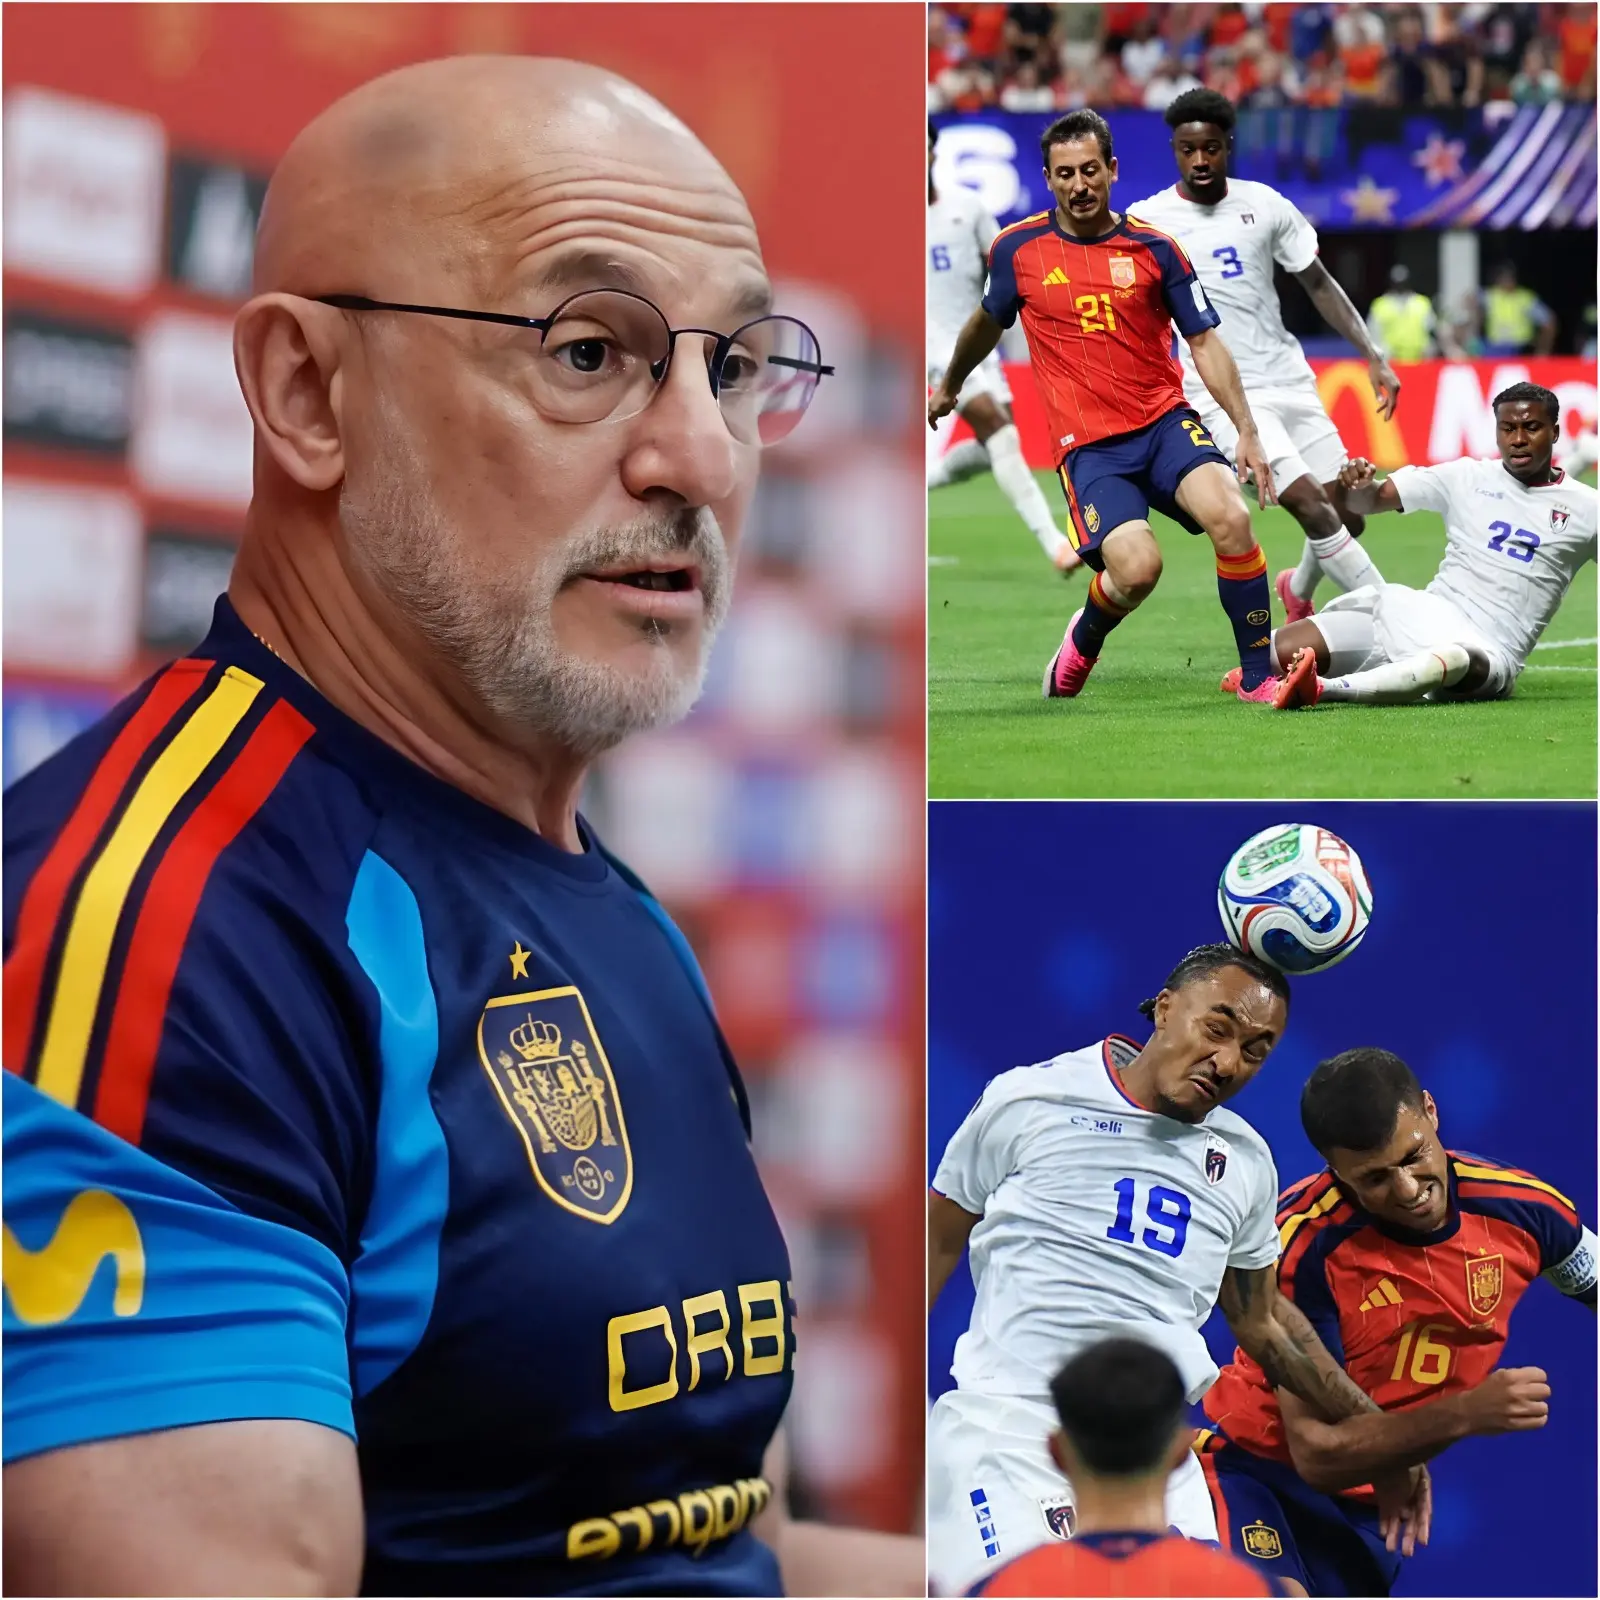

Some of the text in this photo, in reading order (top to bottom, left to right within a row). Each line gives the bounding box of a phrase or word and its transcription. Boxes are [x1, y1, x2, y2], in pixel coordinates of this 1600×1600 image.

[1213, 246, 1244, 279] 3
[1075, 293, 1116, 333] 21
[1487, 520, 1541, 563] 23
[1106, 1177, 1192, 1259] 19
[607, 1279, 797, 1412] ORB
[1390, 1321, 1451, 1385] 16
